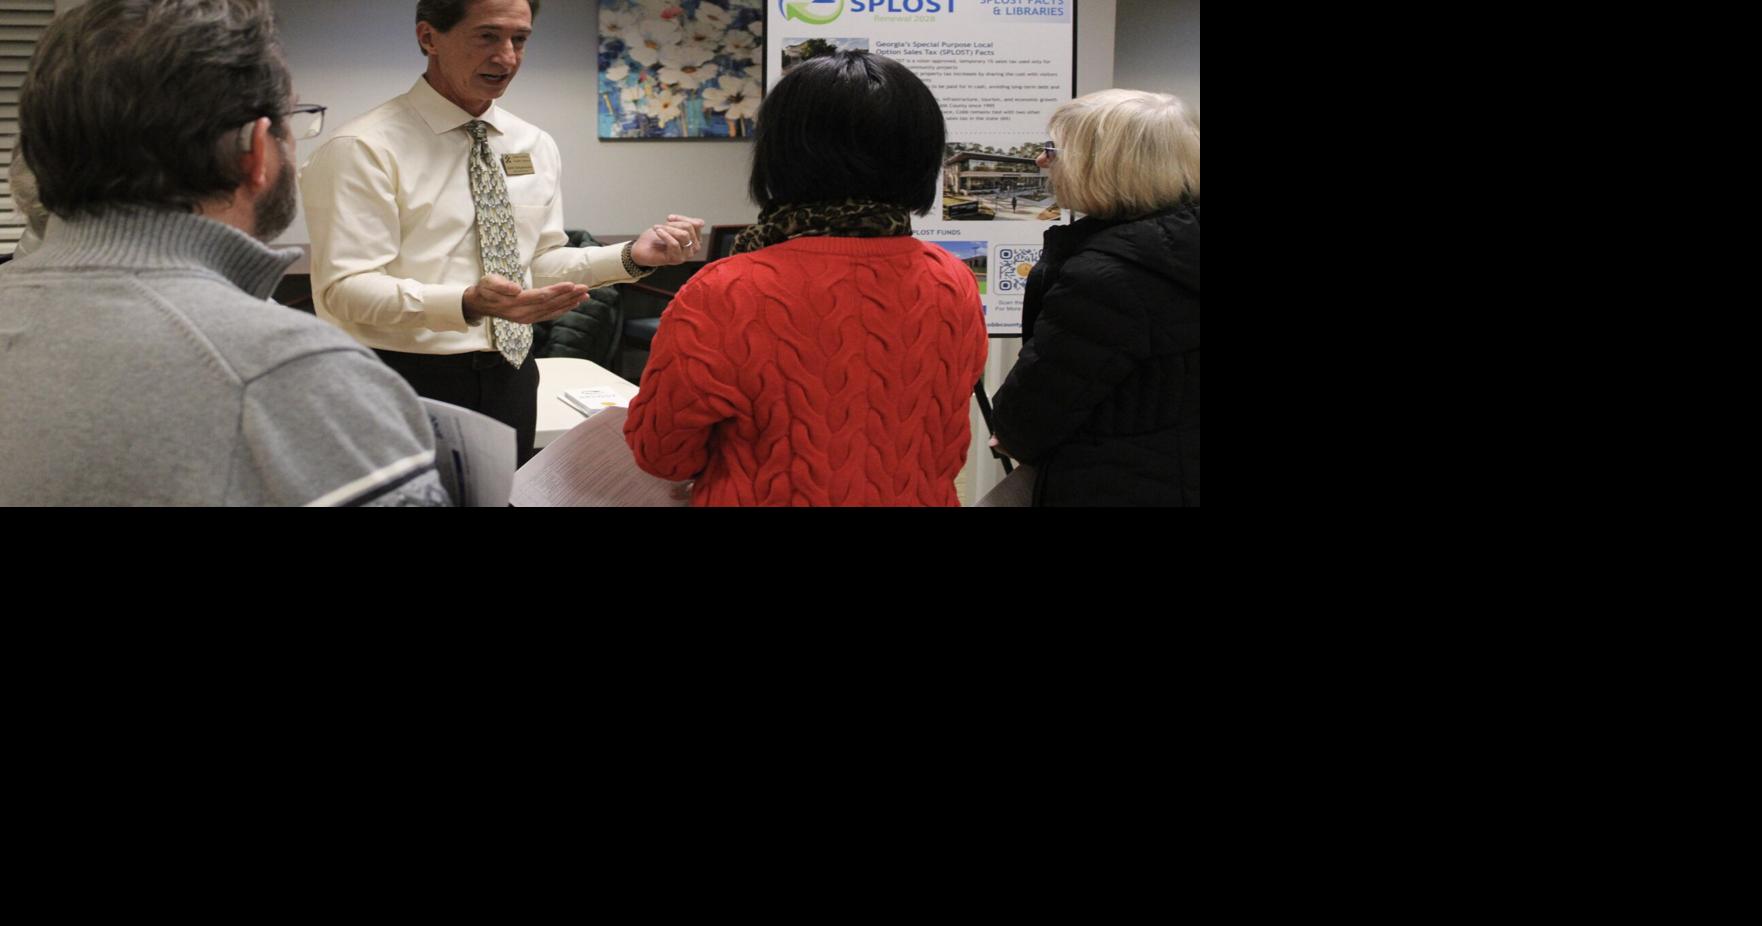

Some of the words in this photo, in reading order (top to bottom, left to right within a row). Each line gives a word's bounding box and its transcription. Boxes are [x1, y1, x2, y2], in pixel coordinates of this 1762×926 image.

[850, 0, 957, 13] SPLOST
[993, 7, 1001, 15] &
[1006, 7, 1064, 16] LIBRARIES
[876, 41, 910, 50] Georgia's
[913, 41, 939, 50] Special
[941, 42, 971, 50] Purpose
[876, 49, 901, 57] Option
[939, 49, 973, 57] (SPLOST)
